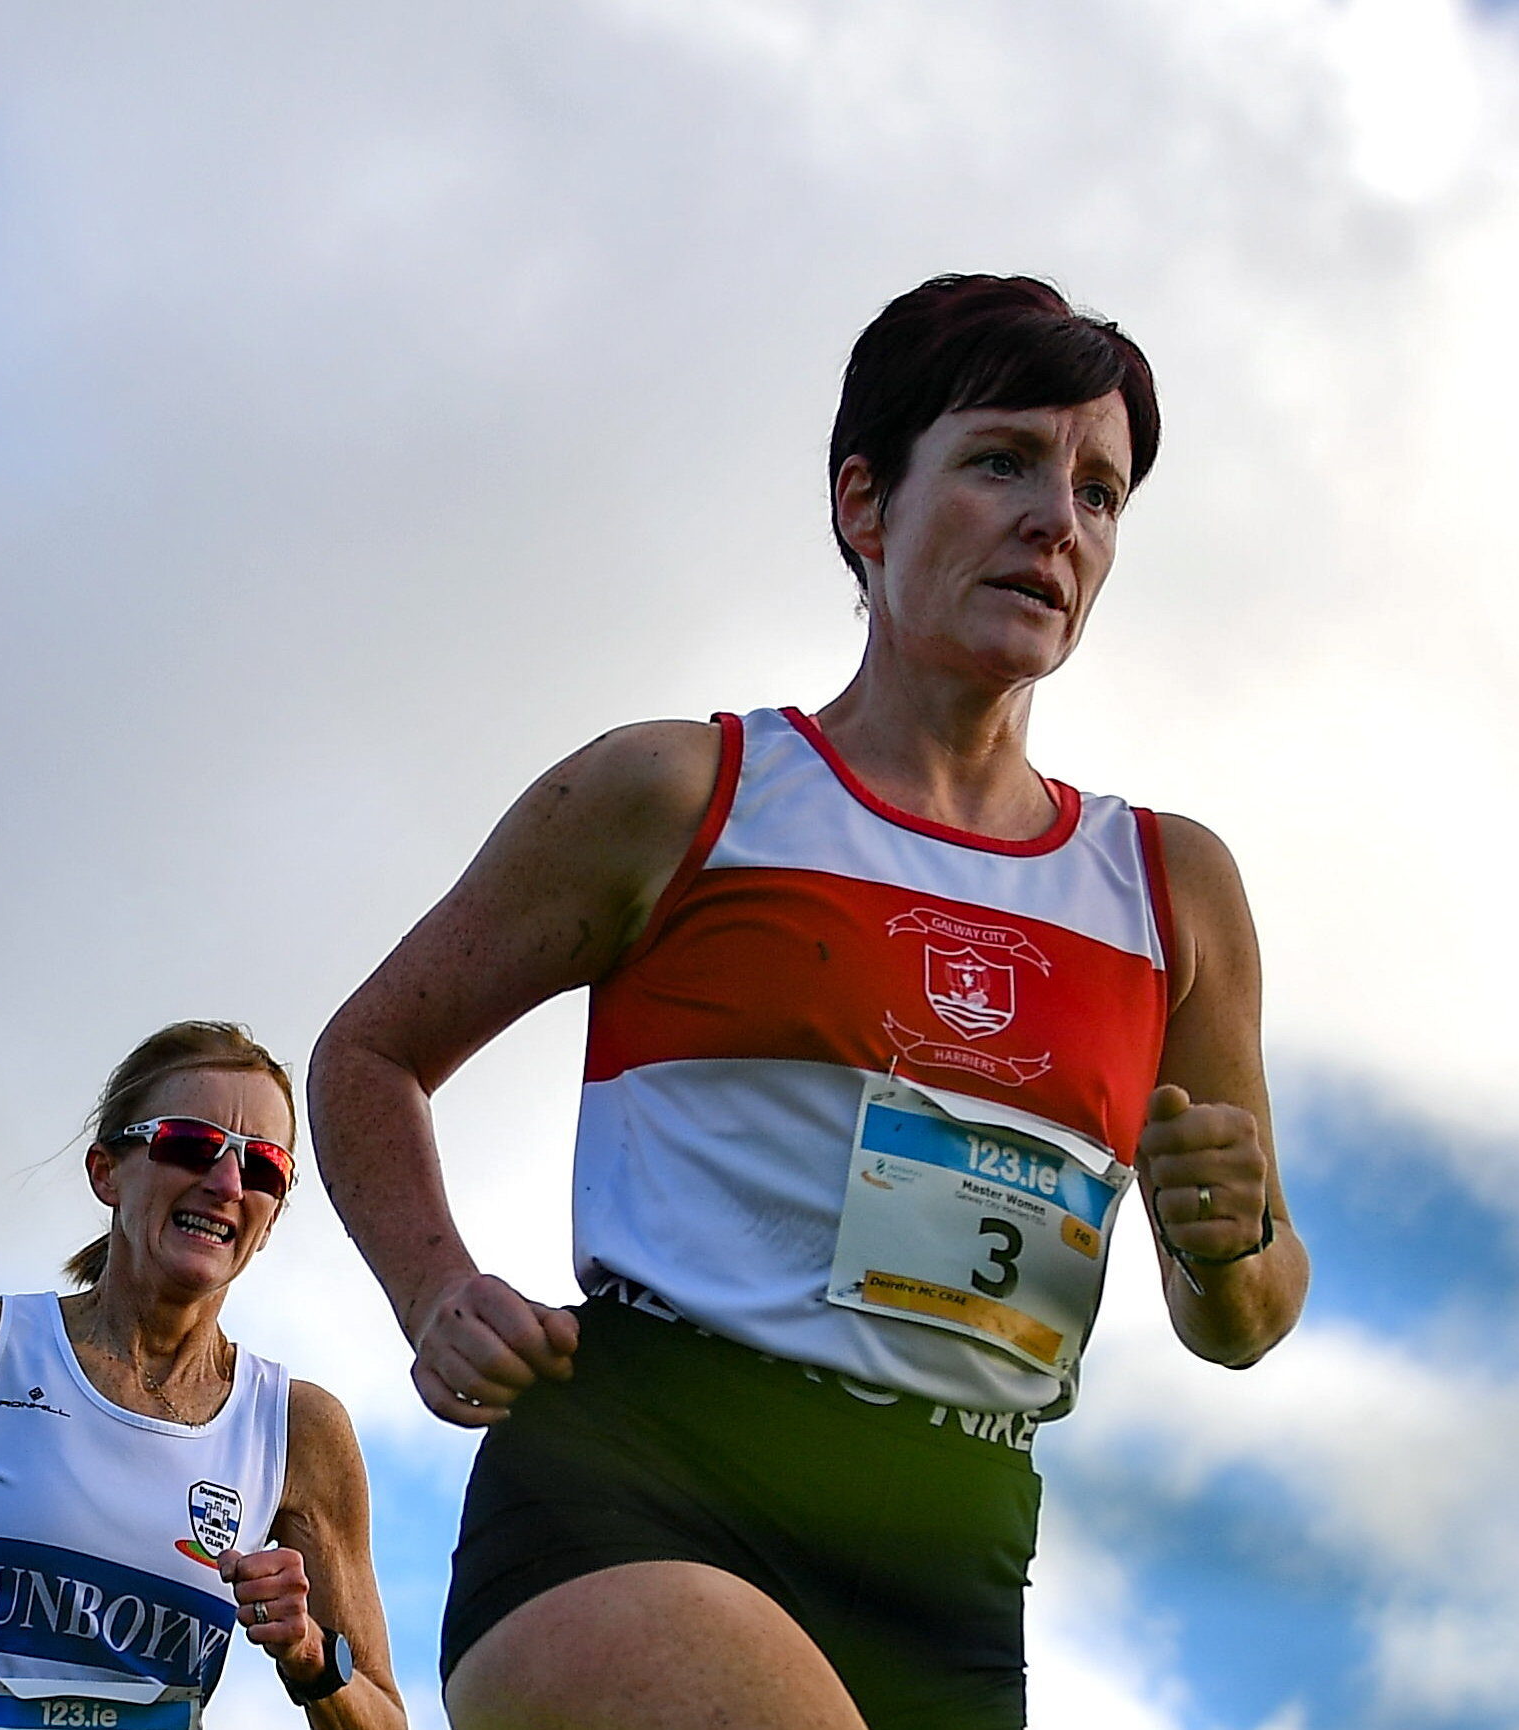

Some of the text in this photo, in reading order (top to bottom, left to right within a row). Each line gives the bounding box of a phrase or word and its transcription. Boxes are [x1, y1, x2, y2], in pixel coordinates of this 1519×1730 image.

[932, 918, 1007, 943] GALWAY CITY
[934, 1049, 996, 1073] HARRIERS
[967, 1134, 1058, 1195] 123.ie
[962, 1180, 1046, 1216] Master Women
[971, 1217, 1024, 1299] 3
[870, 1277, 915, 1293] Deirdre
[199, 1486, 236, 1506] DUNBOYNE
[198, 1524, 230, 1543] ATHLETIC
[204, 1536, 224, 1550] CLUB
[41, 1701, 118, 1727] 123.ie
